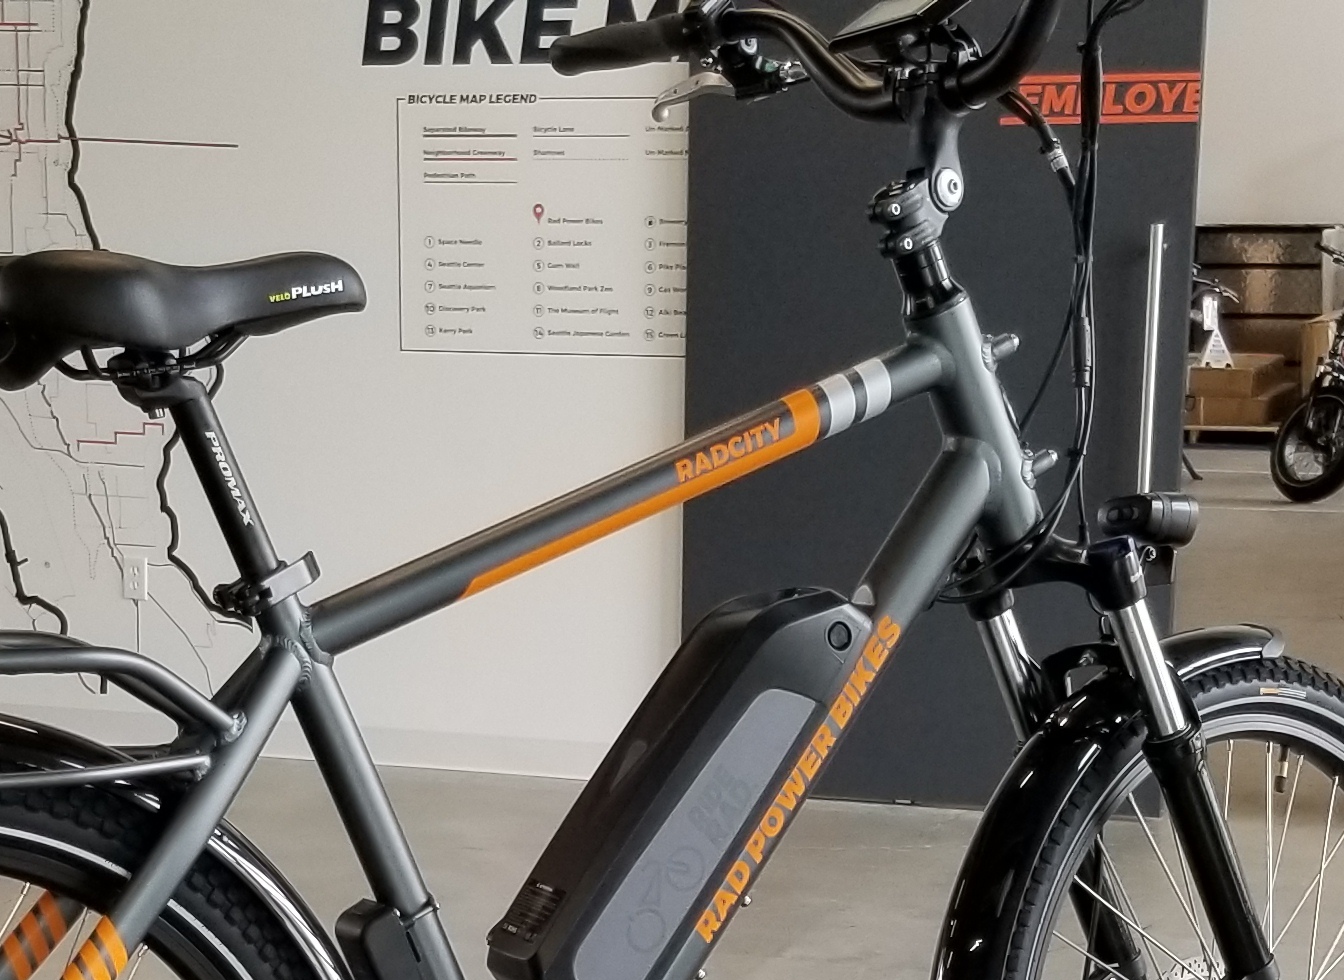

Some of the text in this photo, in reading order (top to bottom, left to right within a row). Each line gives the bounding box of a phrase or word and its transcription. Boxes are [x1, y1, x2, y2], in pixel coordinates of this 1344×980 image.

[362, 0, 578, 66] BIKE
[407, 94, 537, 104] BICYCLE MAP LEGEND
[1019, 82, 1201, 115] EMLOYE
[269, 279, 344, 303] VELO PLUSH
[205, 431, 255, 527] PROMAX
[674, 417, 781, 483] RADCITY
[694, 615, 902, 943] RAD POWER BIKES
